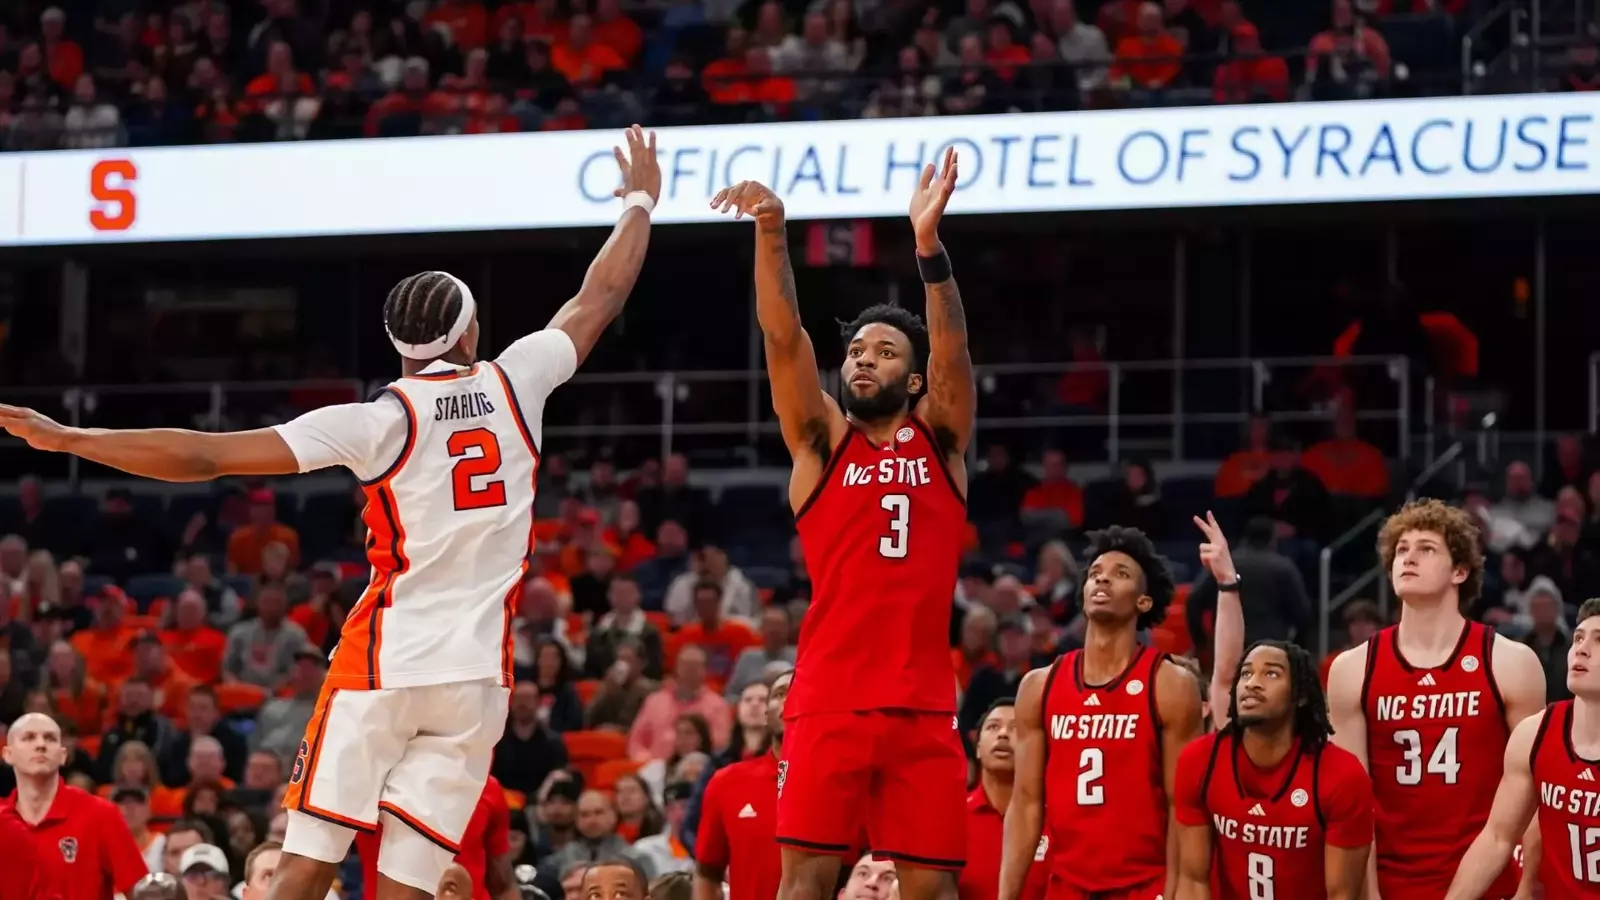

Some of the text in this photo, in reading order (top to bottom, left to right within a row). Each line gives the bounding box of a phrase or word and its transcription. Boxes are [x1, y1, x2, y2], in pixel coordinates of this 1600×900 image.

[578, 114, 1593, 203] OFICIAL HOTEL OF SYRACUSE
[90, 160, 137, 231] S
[446, 426, 508, 511] 2
[842, 462, 876, 487] NC
[879, 493, 910, 558] 3
[1050, 713, 1140, 740] NC STATE
[1377, 691, 1481, 721] NC STATE
[1076, 747, 1104, 806] 2
[1393, 727, 1461, 785] 34
[1541, 781, 1566, 810] NC
[1213, 813, 1309, 849] NC STATE
[1247, 851, 1275, 900] 8
